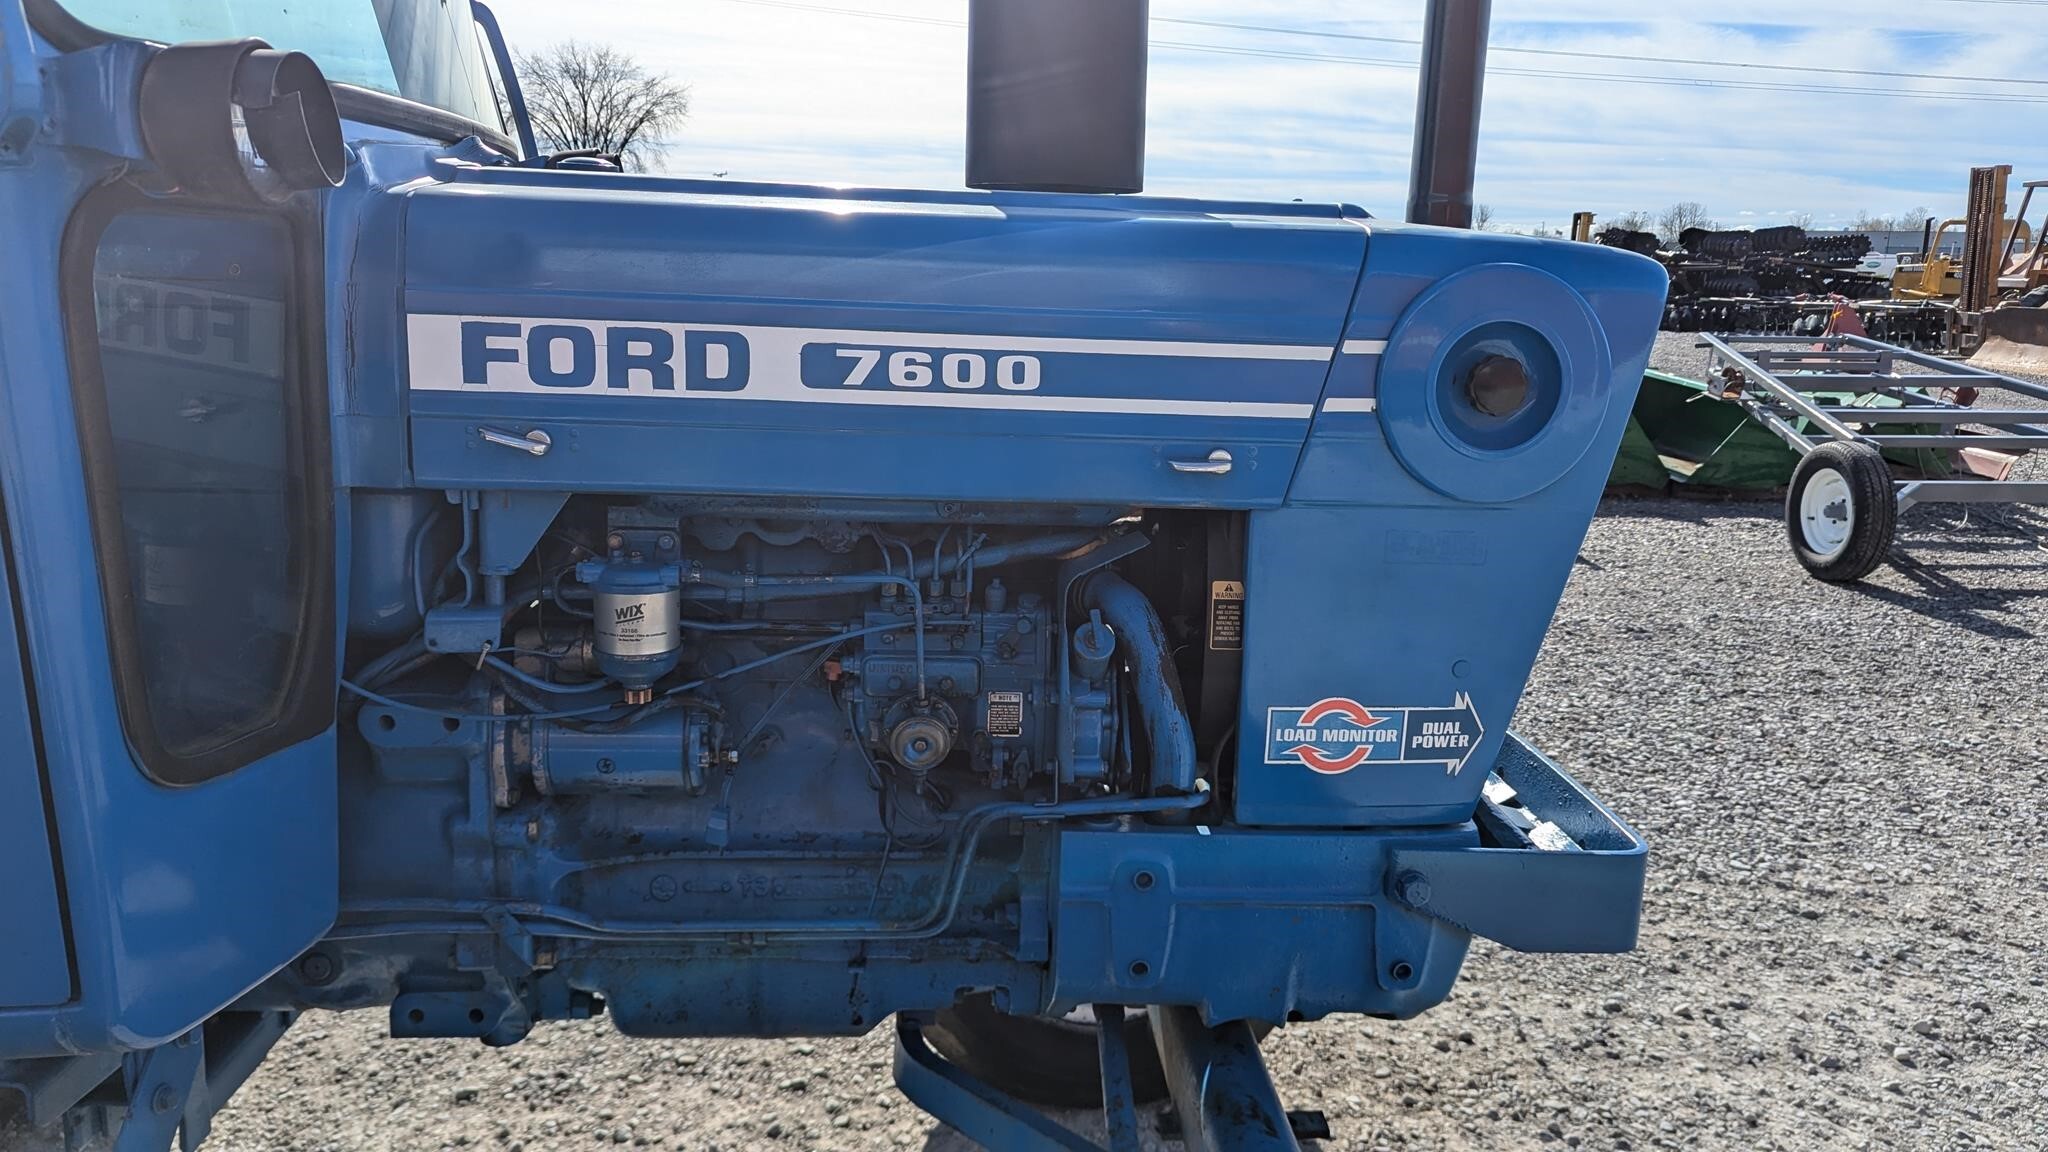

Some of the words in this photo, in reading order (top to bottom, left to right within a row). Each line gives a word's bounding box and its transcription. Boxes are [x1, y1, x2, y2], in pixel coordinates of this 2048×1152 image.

[460, 321, 751, 393] FORD
[834, 347, 1042, 392] 7600
[615, 603, 644, 620] WIX
[1275, 728, 1317, 742] LOAD
[1322, 728, 1398, 742] MONITOR
[1422, 721, 1462, 735] DUAL
[1411, 734, 1470, 749] POWER
